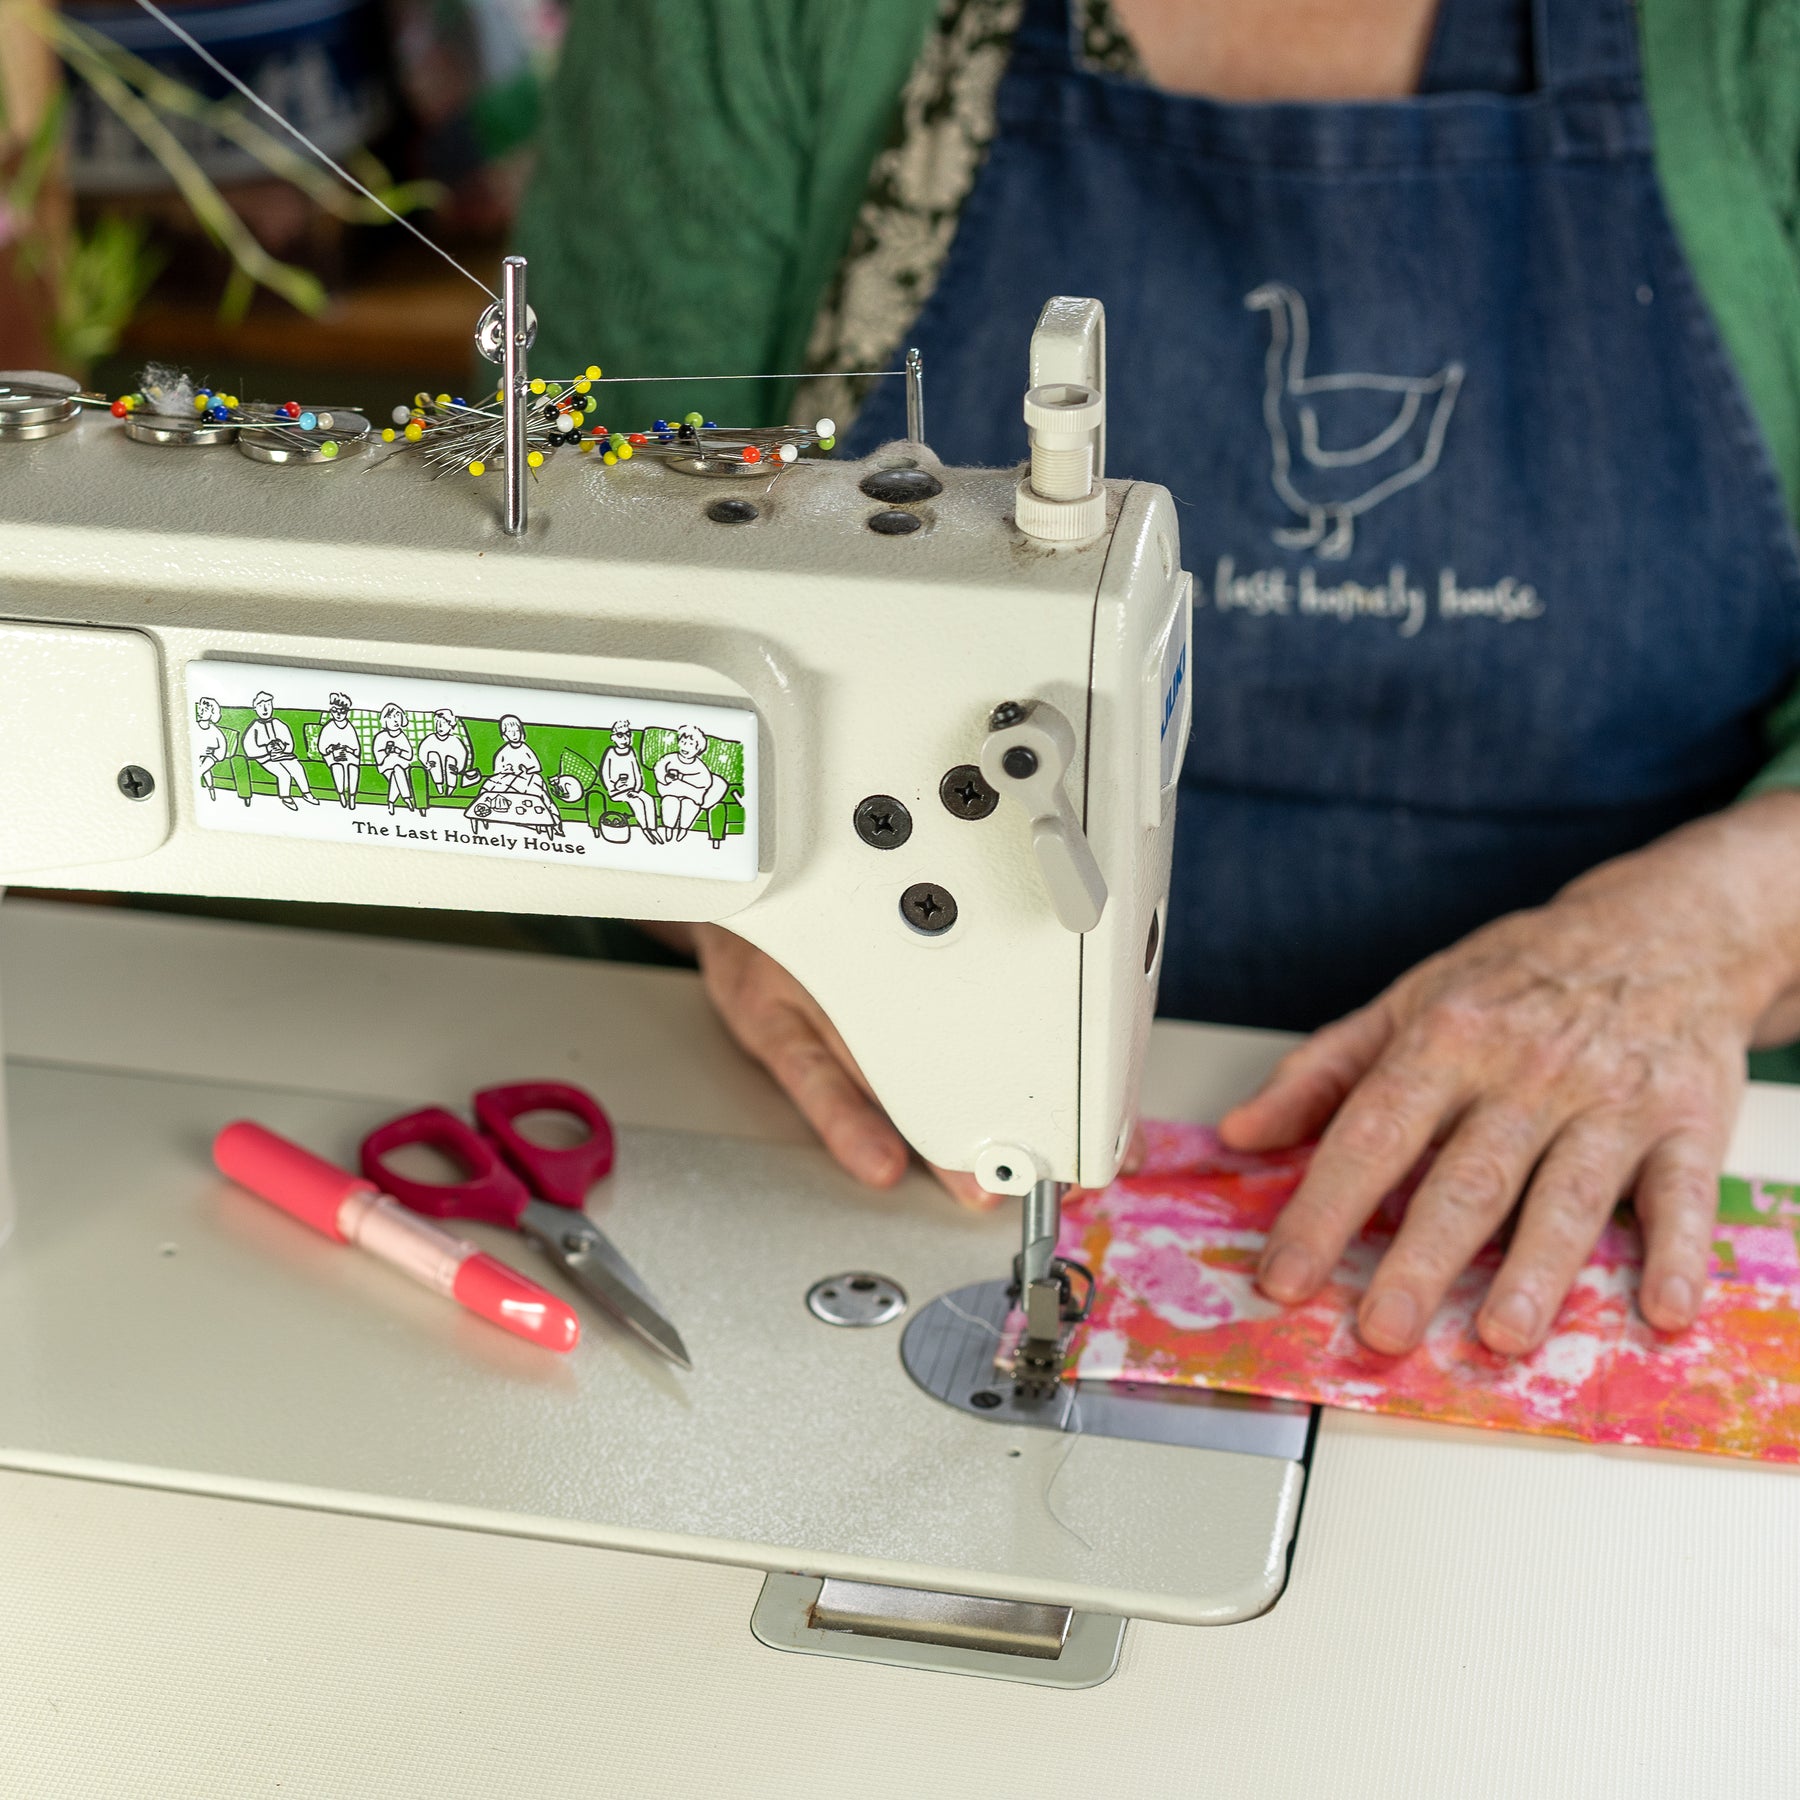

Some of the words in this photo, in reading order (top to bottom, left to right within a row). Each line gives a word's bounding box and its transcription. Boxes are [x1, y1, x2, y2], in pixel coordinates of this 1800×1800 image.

[1215, 554, 1292, 615] last
[1299, 564, 1426, 638] homely
[352, 821, 390, 836] The
[396, 825, 439, 841] Last
[444, 829, 518, 850] Homely
[524, 837, 586, 855] House
